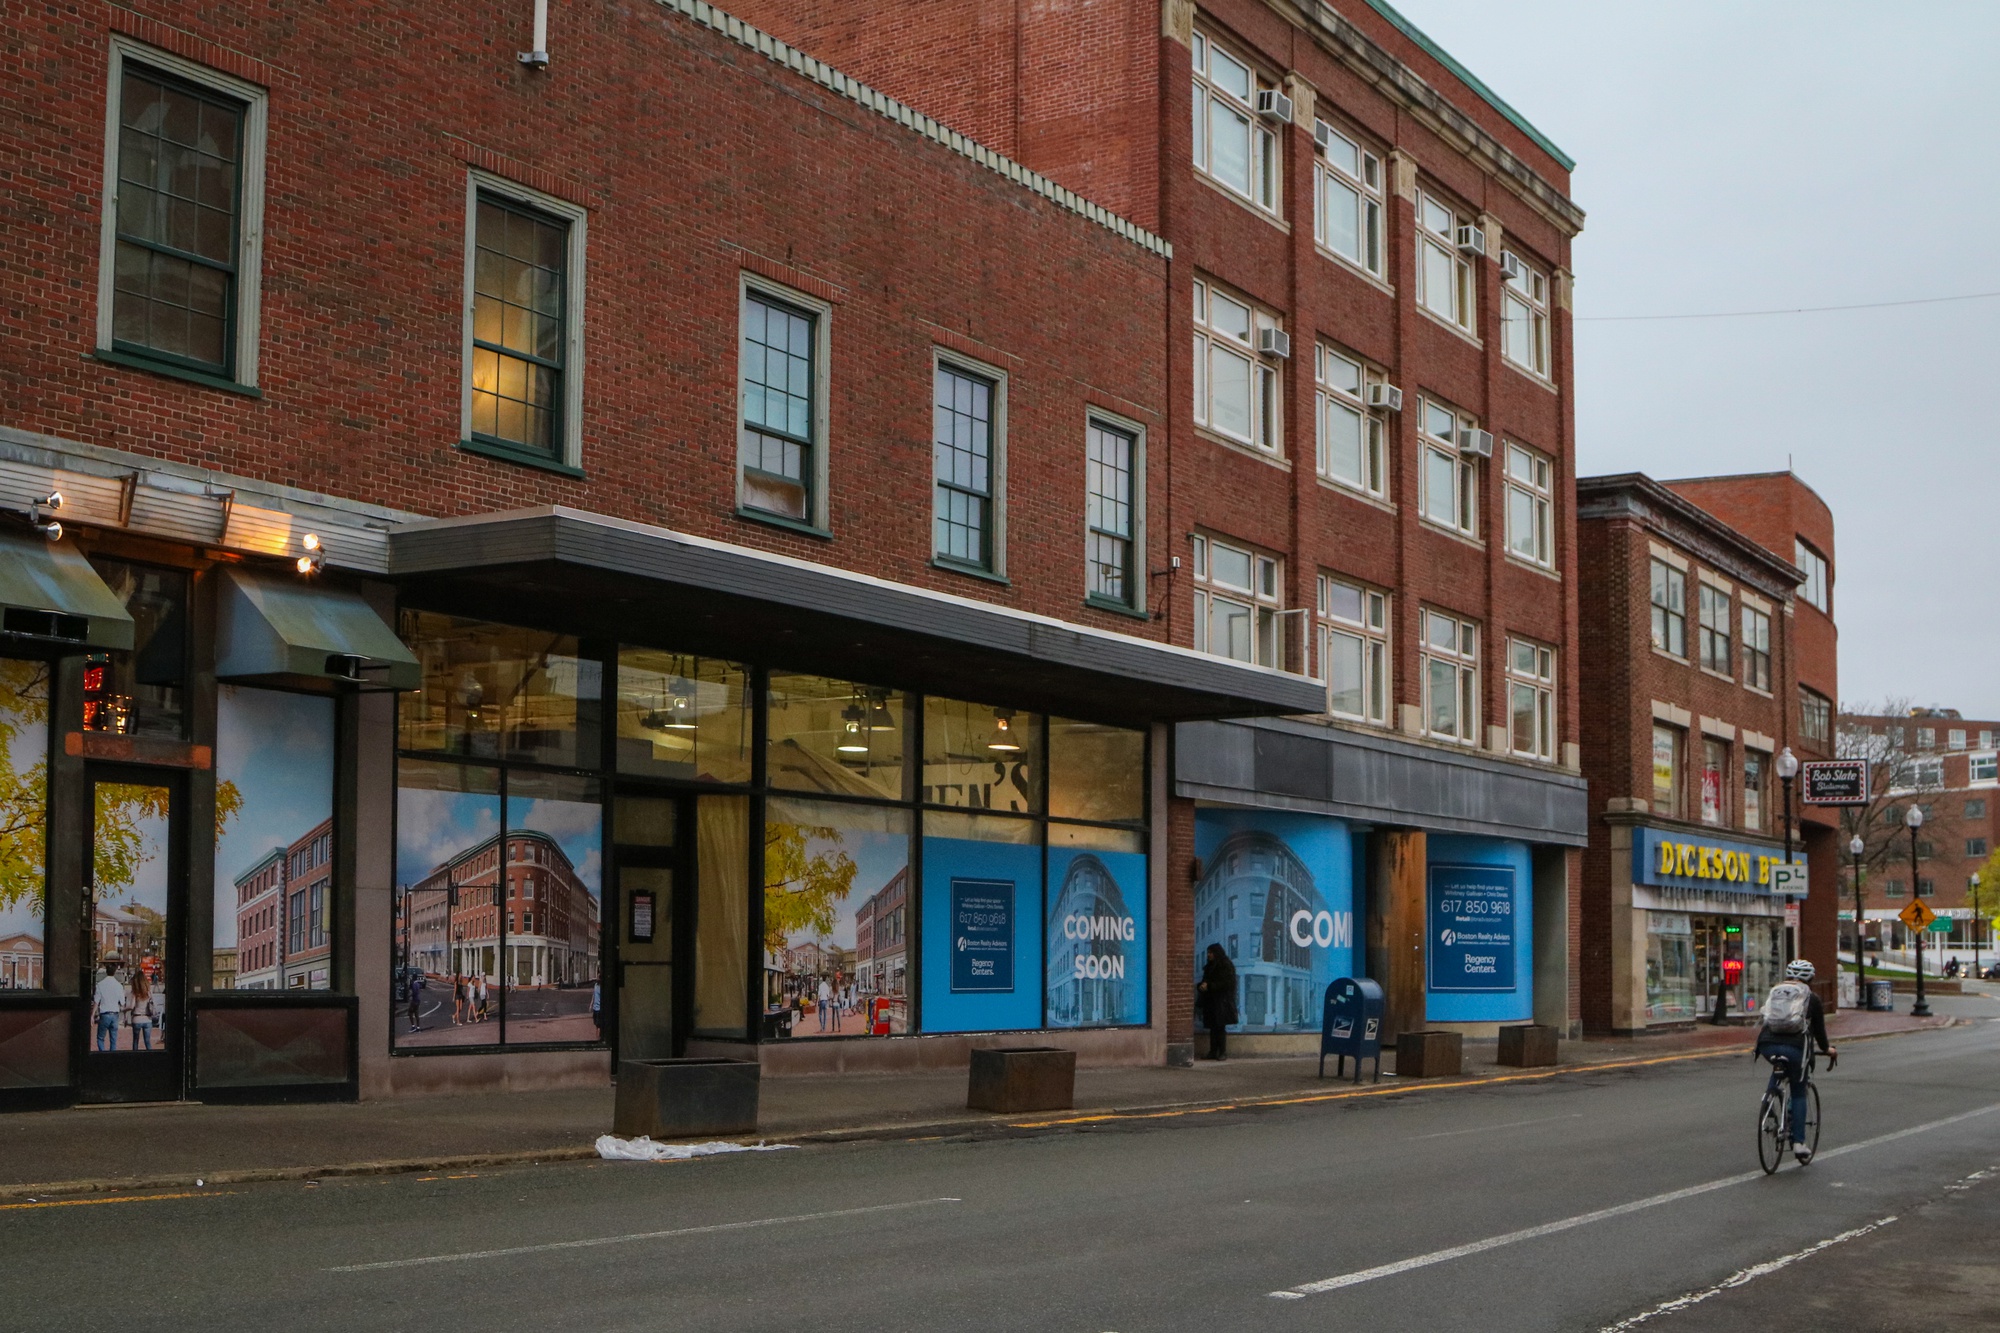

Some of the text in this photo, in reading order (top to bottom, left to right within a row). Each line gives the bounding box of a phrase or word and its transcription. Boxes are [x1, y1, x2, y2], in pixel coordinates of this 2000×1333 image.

[1812, 769, 1857, 781] Bob Slate
[1660, 841, 1750, 882] DICKSON
[1441, 899, 1510, 914] 617 850 9618
[959, 911, 1006, 925] 617 850 9618
[1064, 915, 1134, 941] COMING
[972, 958, 994, 968] Regency
[1074, 954, 1125, 979] SOON
[1465, 954, 1496, 965] Regency
